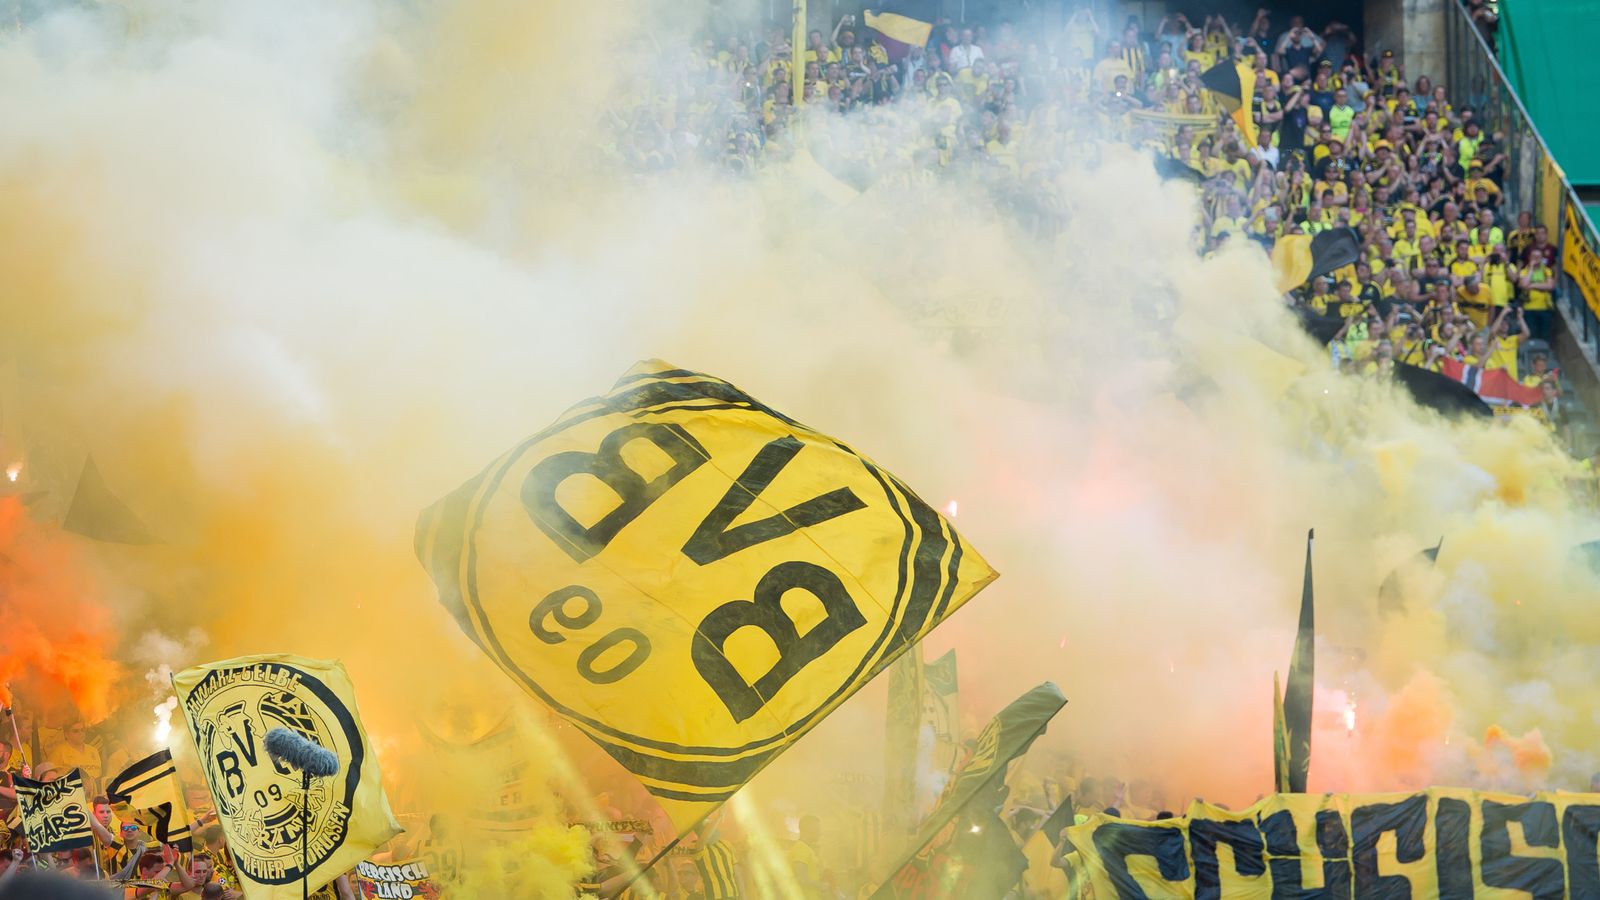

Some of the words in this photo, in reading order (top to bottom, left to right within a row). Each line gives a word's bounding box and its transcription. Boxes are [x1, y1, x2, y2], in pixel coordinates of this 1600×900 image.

[254, 783, 283, 809] 09
[28, 804, 87, 852] STARS
[242, 852, 286, 880] REVIER
[358, 861, 430, 882] BERGISCH
[376, 881, 413, 900] LAND
